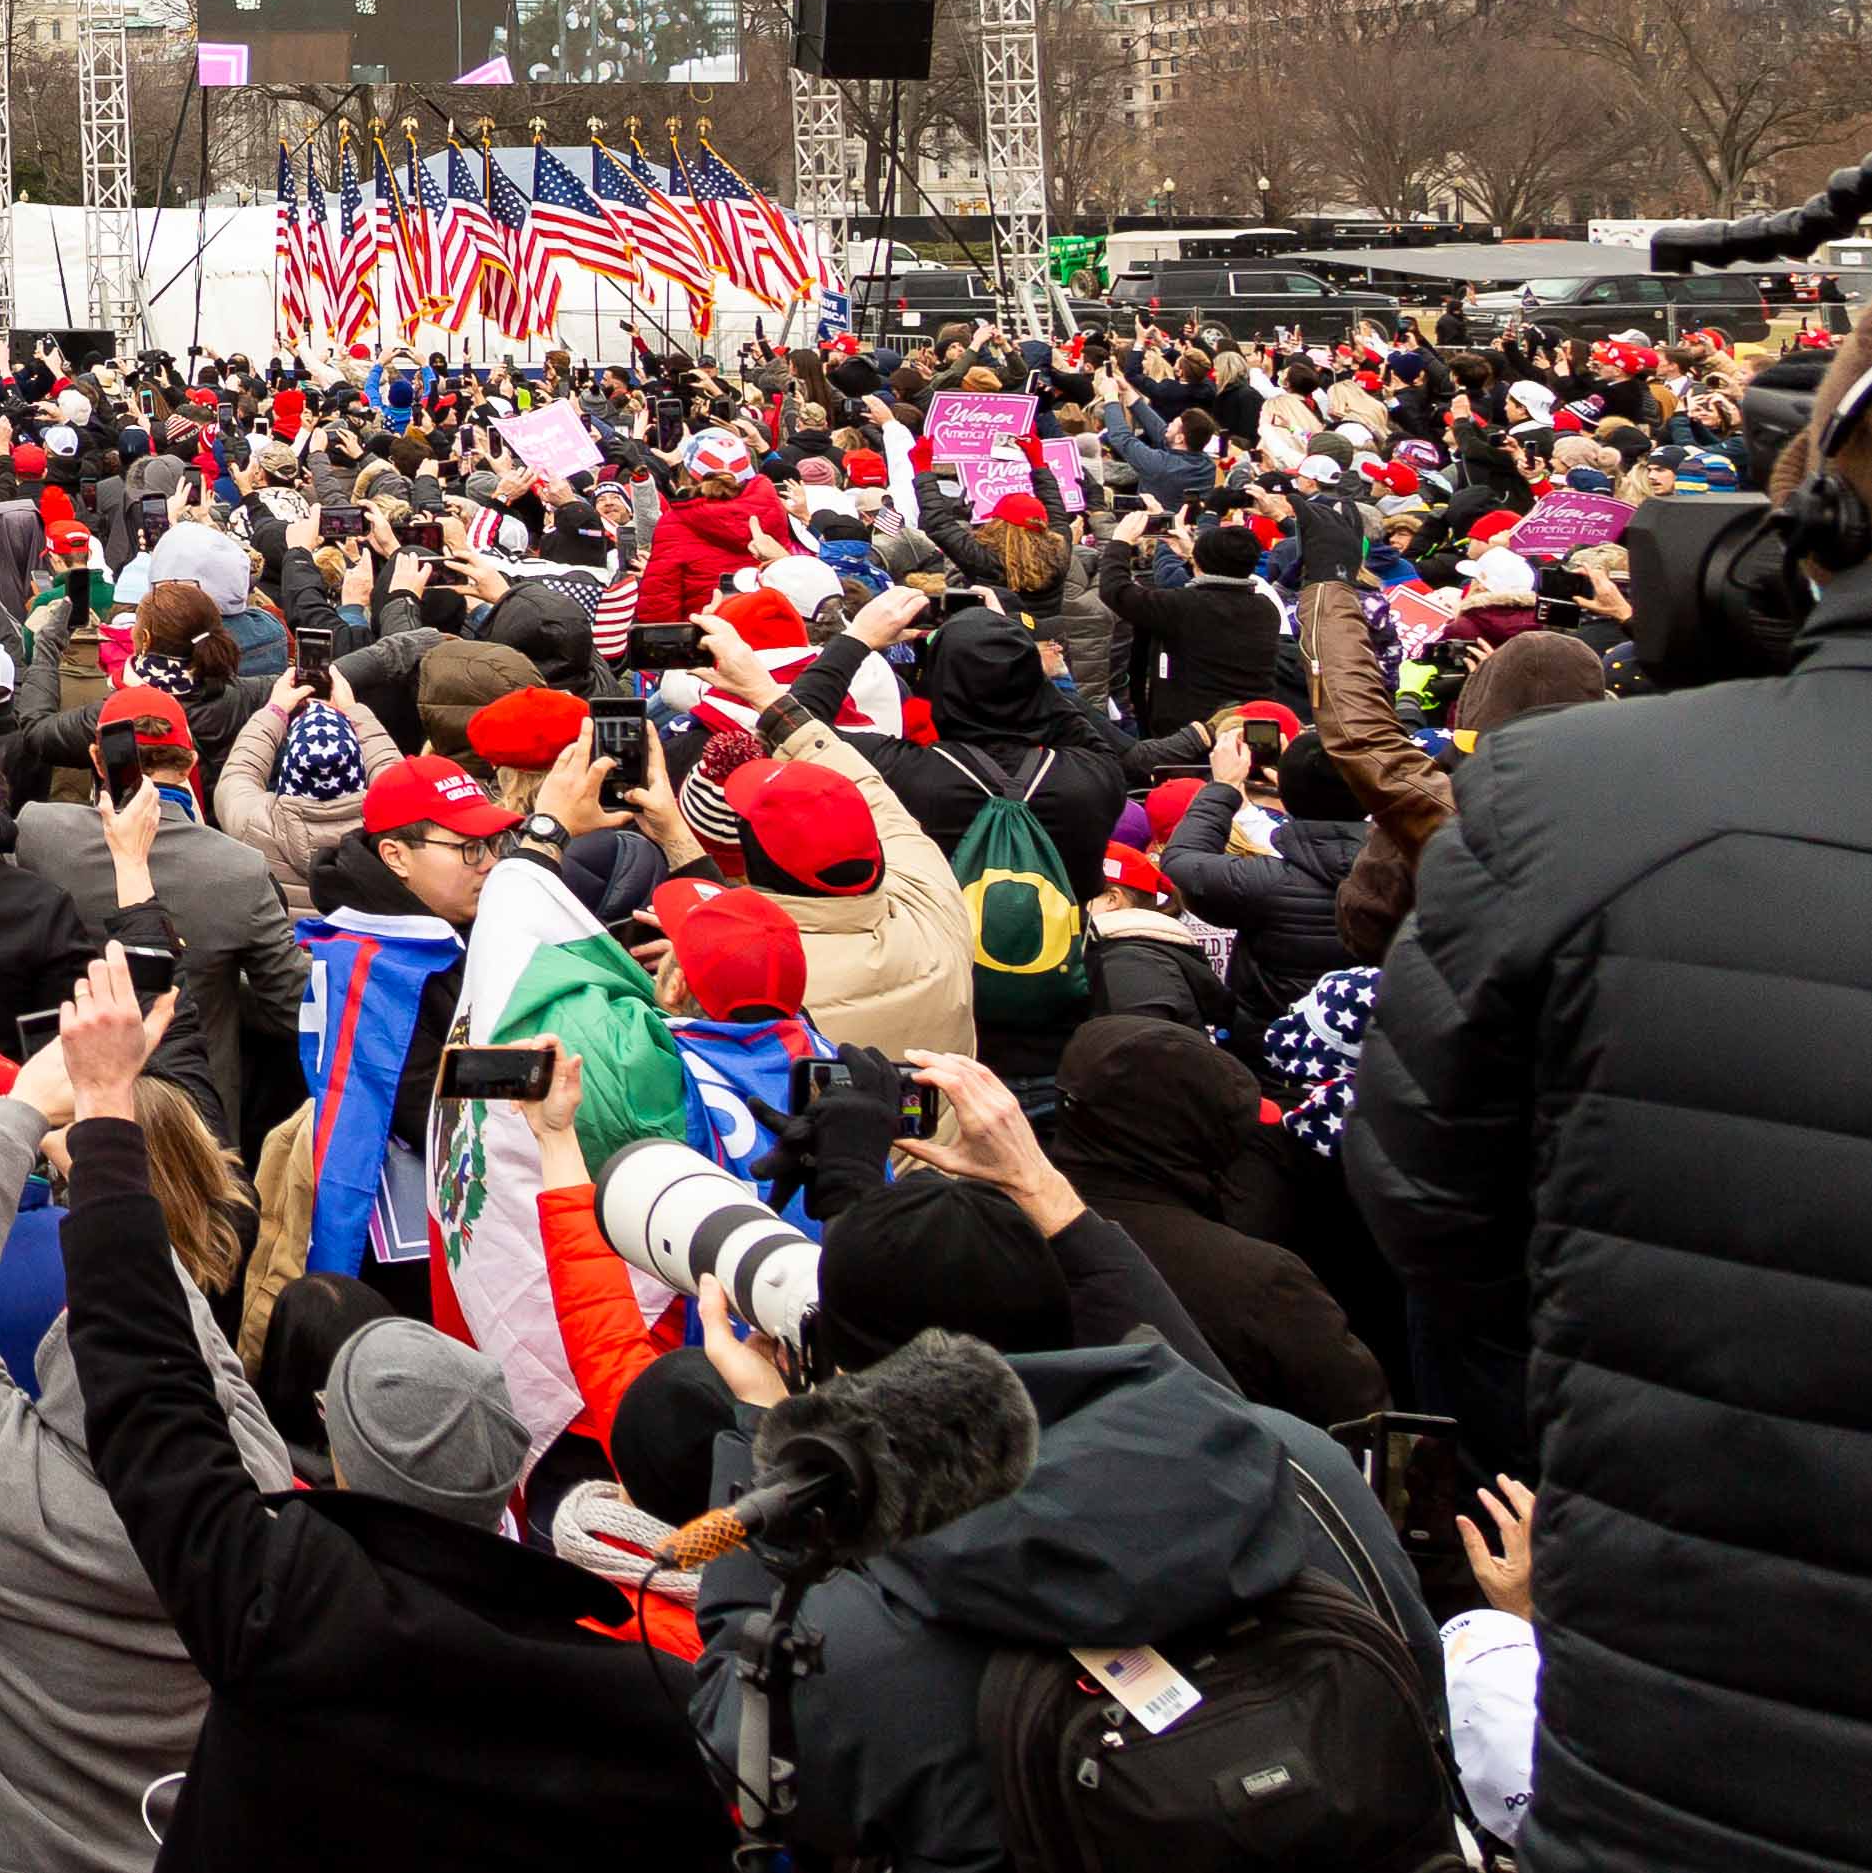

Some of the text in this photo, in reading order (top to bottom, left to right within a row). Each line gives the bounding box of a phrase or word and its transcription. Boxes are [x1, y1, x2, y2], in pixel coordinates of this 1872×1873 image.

[945, 402, 1014, 425] Women
[941, 428, 984, 440] America
[1536, 500, 1614, 524] Women
[1524, 524, 1609, 538] America First
